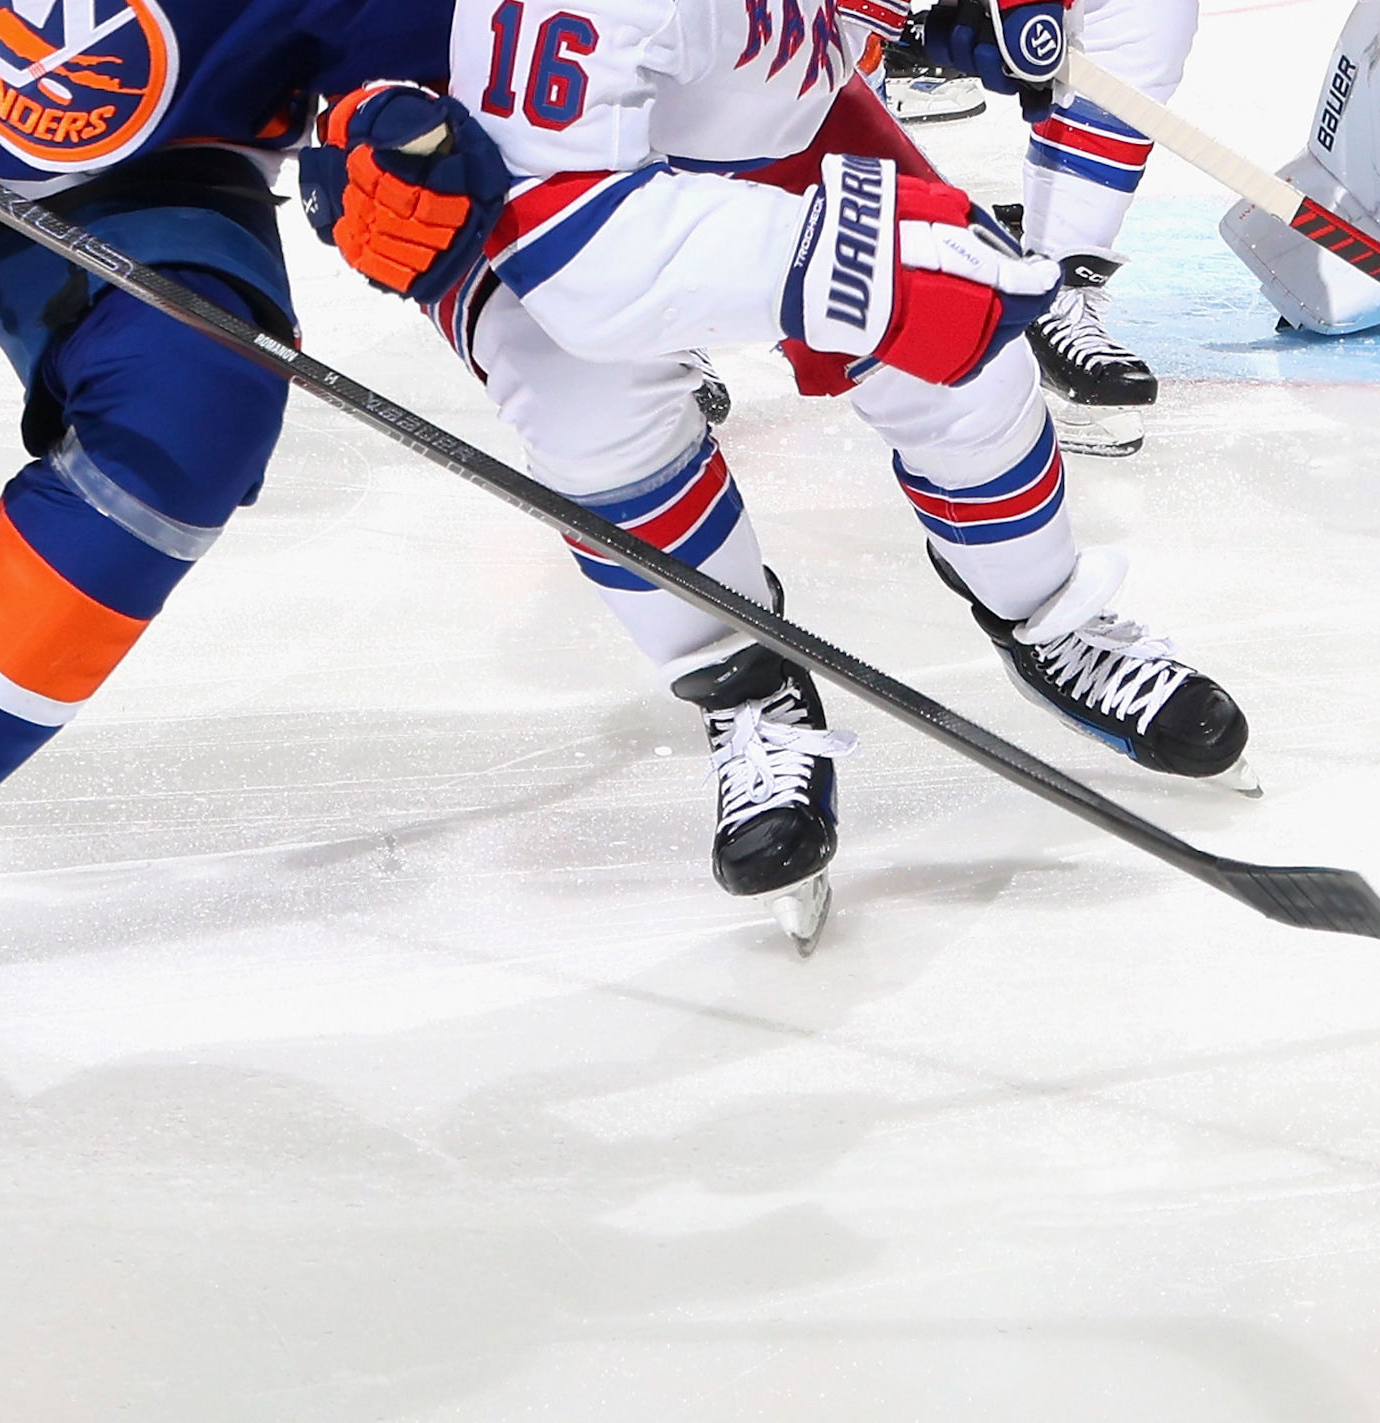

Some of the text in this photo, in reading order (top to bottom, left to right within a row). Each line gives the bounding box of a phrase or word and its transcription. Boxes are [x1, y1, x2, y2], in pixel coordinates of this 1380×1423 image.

[1317, 54, 1357, 153] BAUER
[795, 196, 826, 269] TROCHECK
[1074, 264, 1106, 285] CC
[253, 331, 298, 363] ROMANOV
